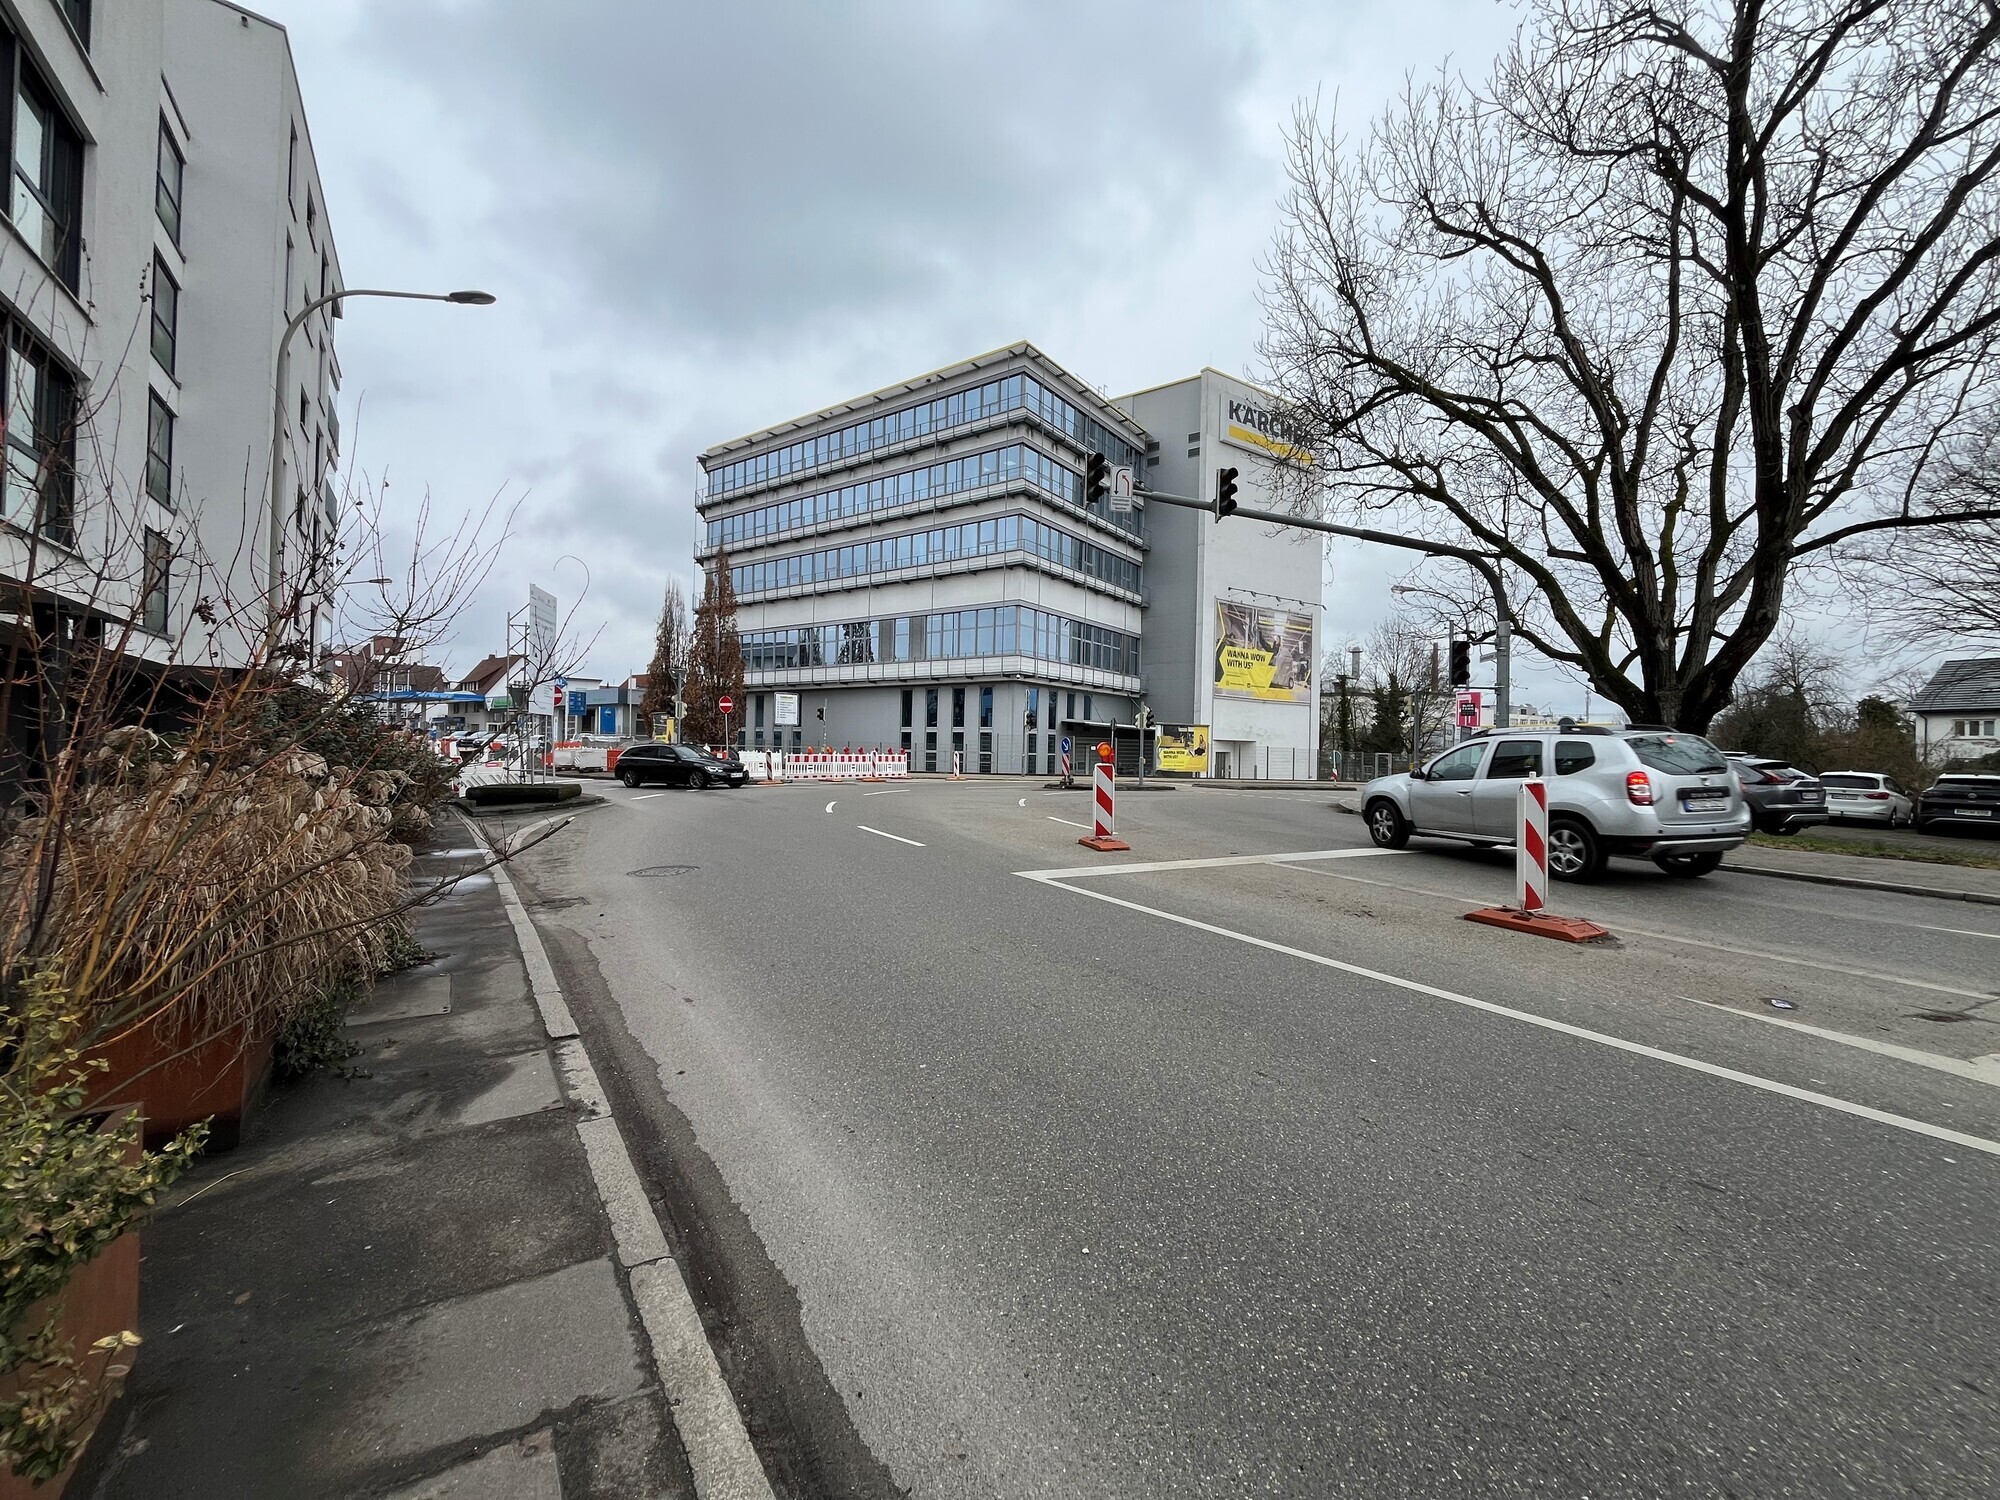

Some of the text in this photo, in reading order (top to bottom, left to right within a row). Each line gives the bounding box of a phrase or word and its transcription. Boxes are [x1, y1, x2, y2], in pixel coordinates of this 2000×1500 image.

[1227, 649, 1266, 662] WANNA WOW
[1227, 659, 1253, 670] WITH US?
